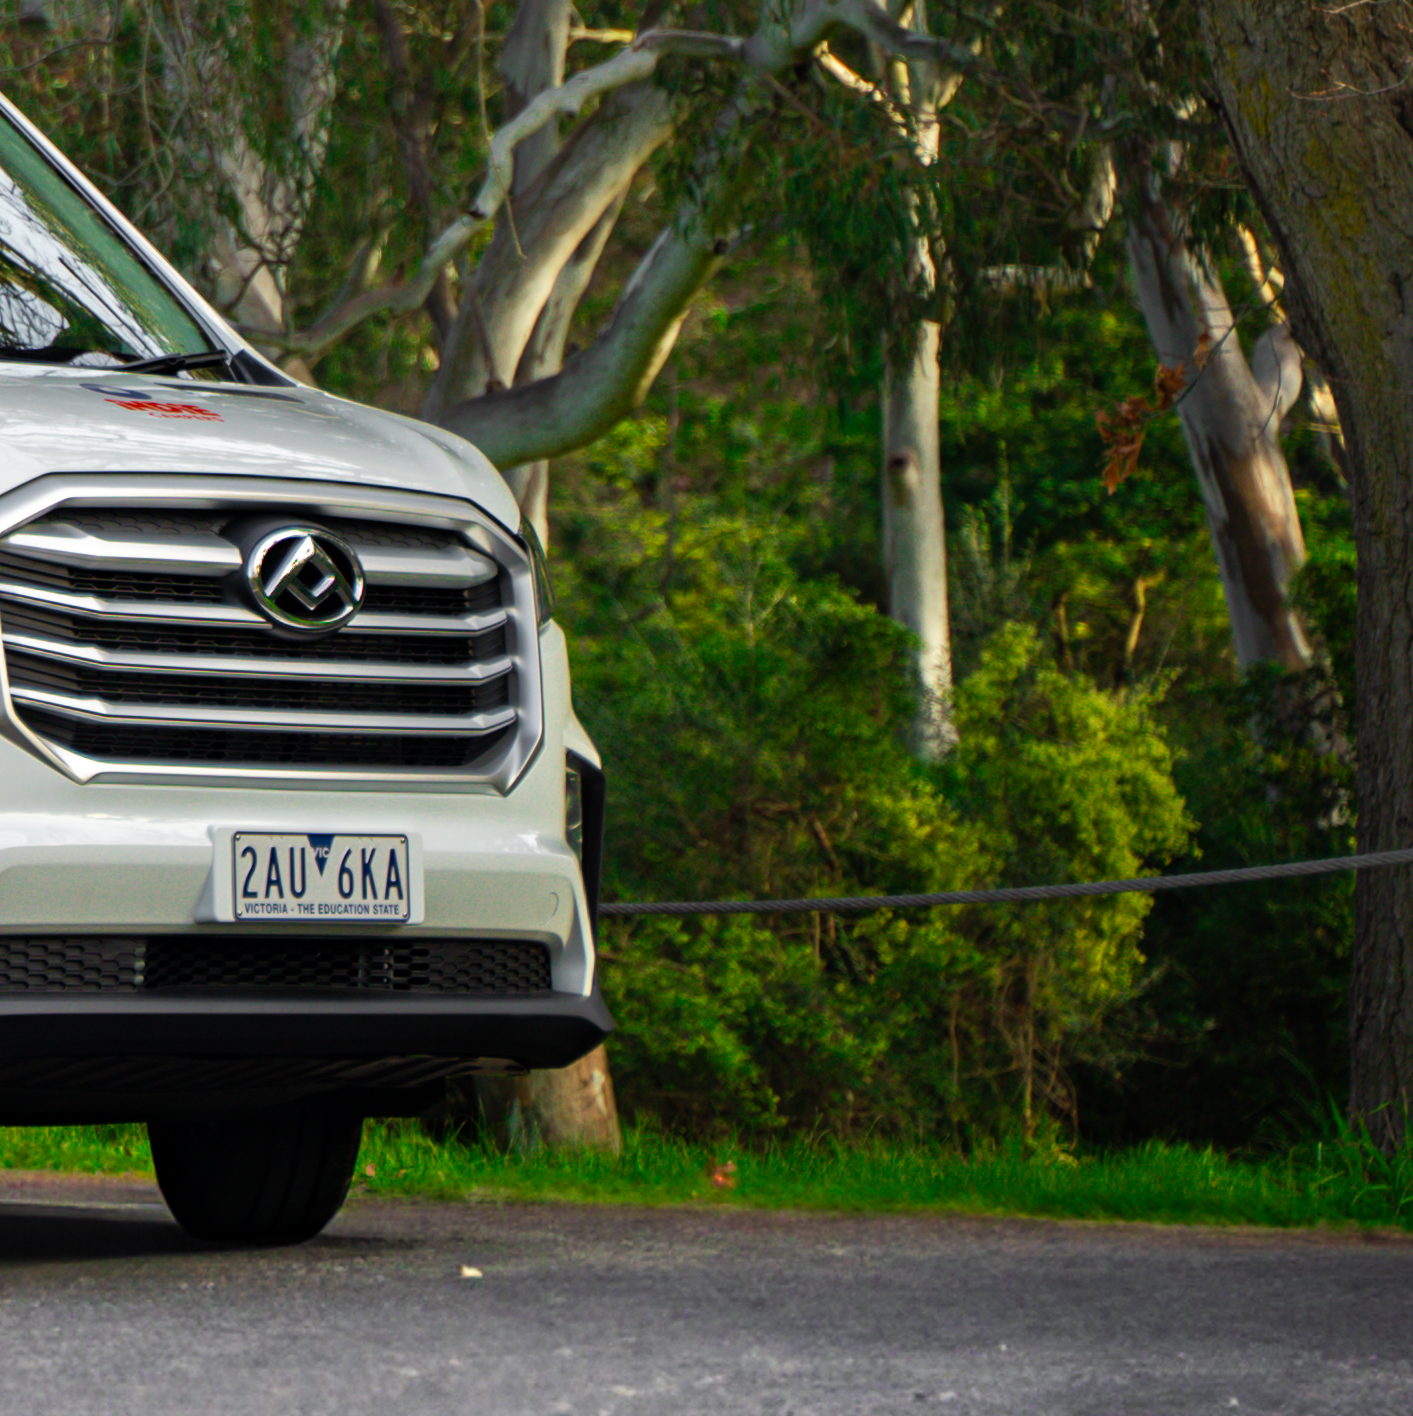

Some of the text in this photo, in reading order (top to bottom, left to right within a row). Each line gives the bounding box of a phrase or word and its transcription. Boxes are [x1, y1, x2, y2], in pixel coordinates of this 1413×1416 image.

[313, 847, 330, 859] VIC
[240, 846, 404, 901] 2AU 6KA
[244, 903, 288, 915] VICTORIA
[297, 903, 315, 915] THE
[318, 903, 370, 916] EDUCATION
[372, 904, 400, 916] STATE
